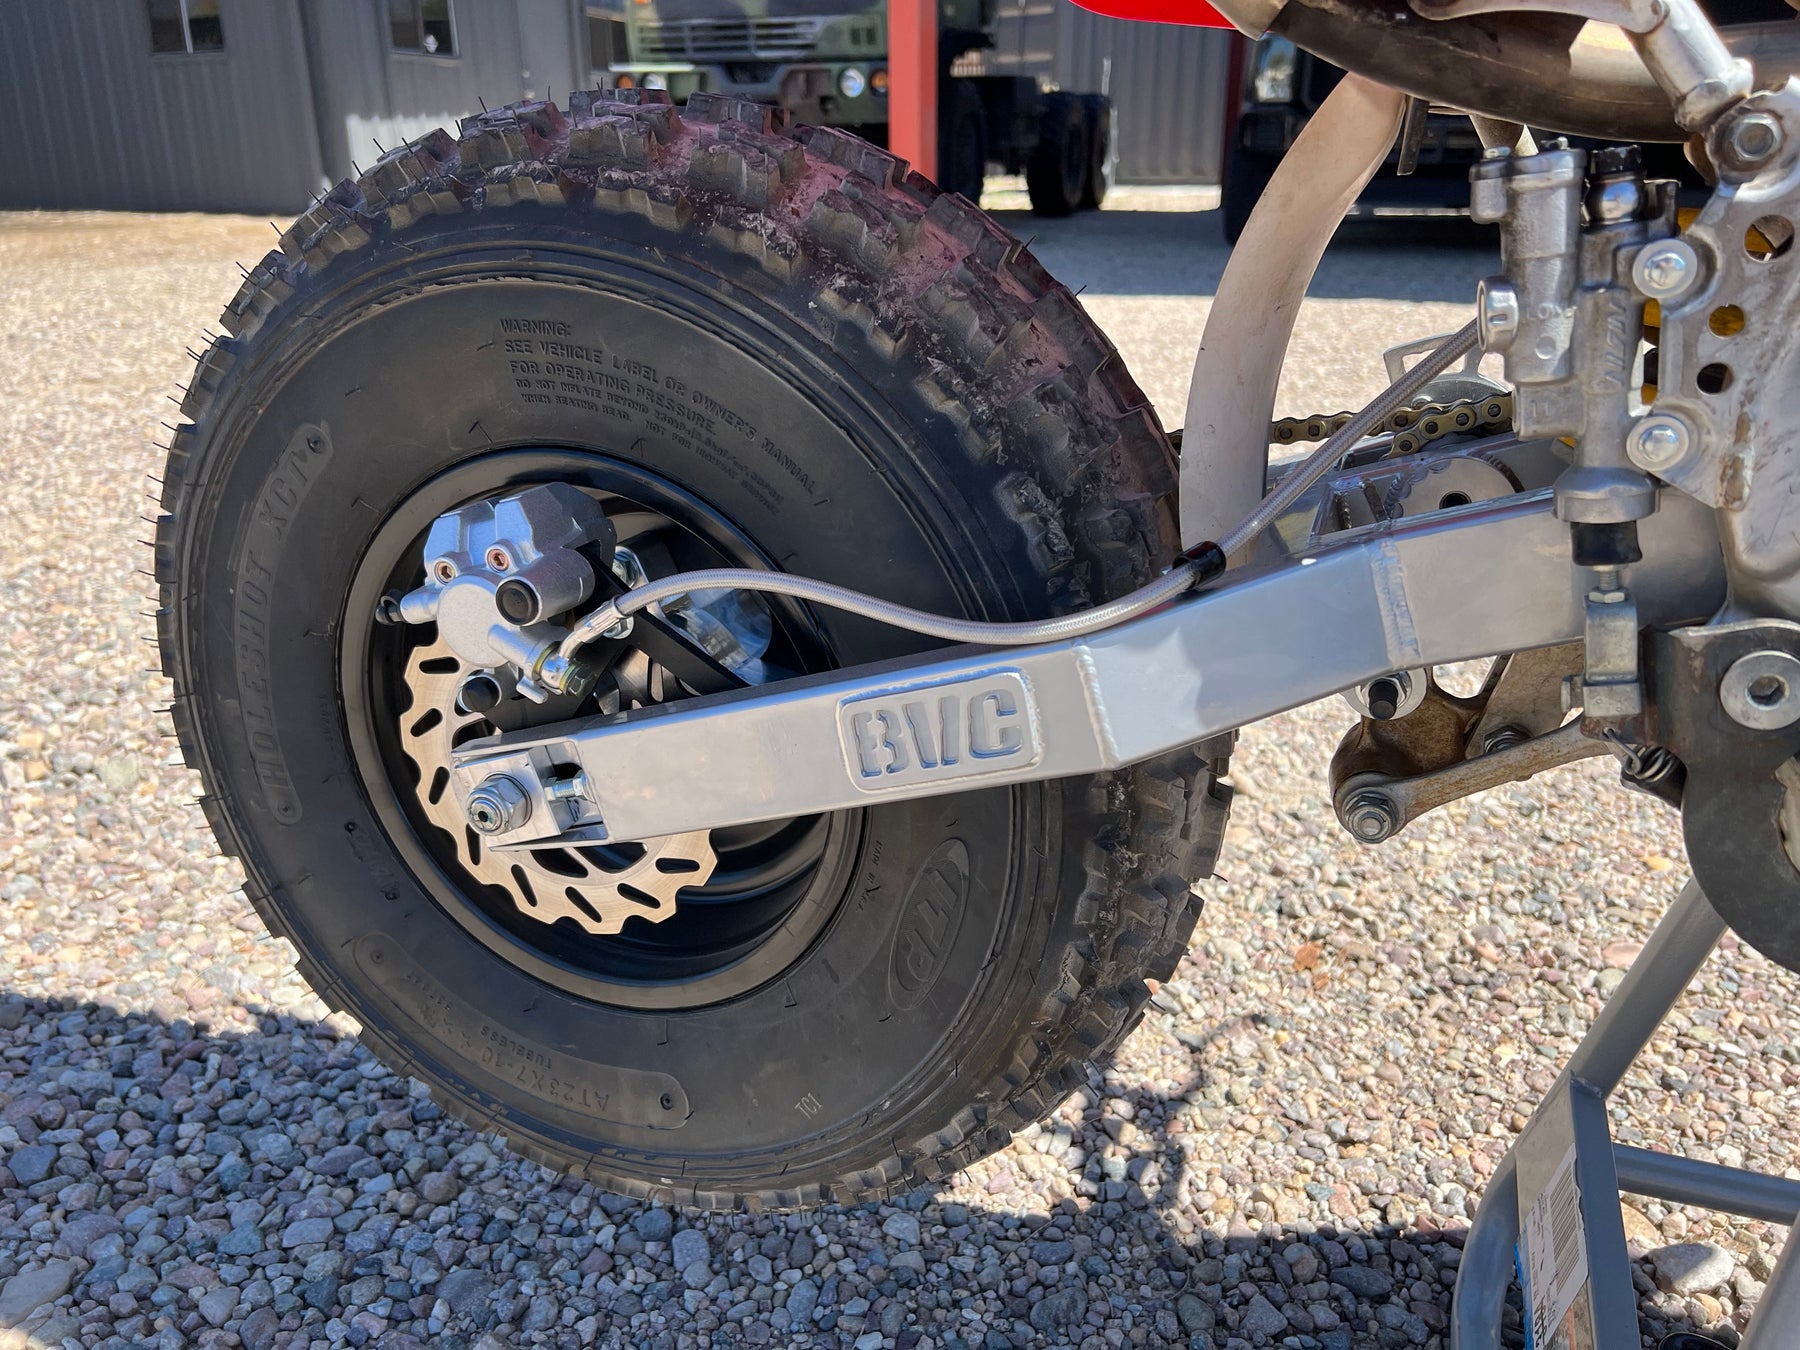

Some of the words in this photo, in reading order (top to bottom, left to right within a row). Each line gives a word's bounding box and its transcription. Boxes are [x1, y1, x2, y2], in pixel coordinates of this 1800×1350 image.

[505, 339, 534, 354] SEE
[538, 341, 603, 365] VEHICLE
[611, 353, 659, 384] LABEL
[664, 376, 685, 396] OR
[692, 390, 758, 441] OWNER'S
[510, 360, 540, 375] FOR
[545, 361, 631, 394] OPERATING
[259, 447, 310, 542] XCT
[239, 548, 290, 790] HOLESHOT
[852, 689, 1023, 778] BVC
[480, 1024, 552, 1070] TUBELESS
